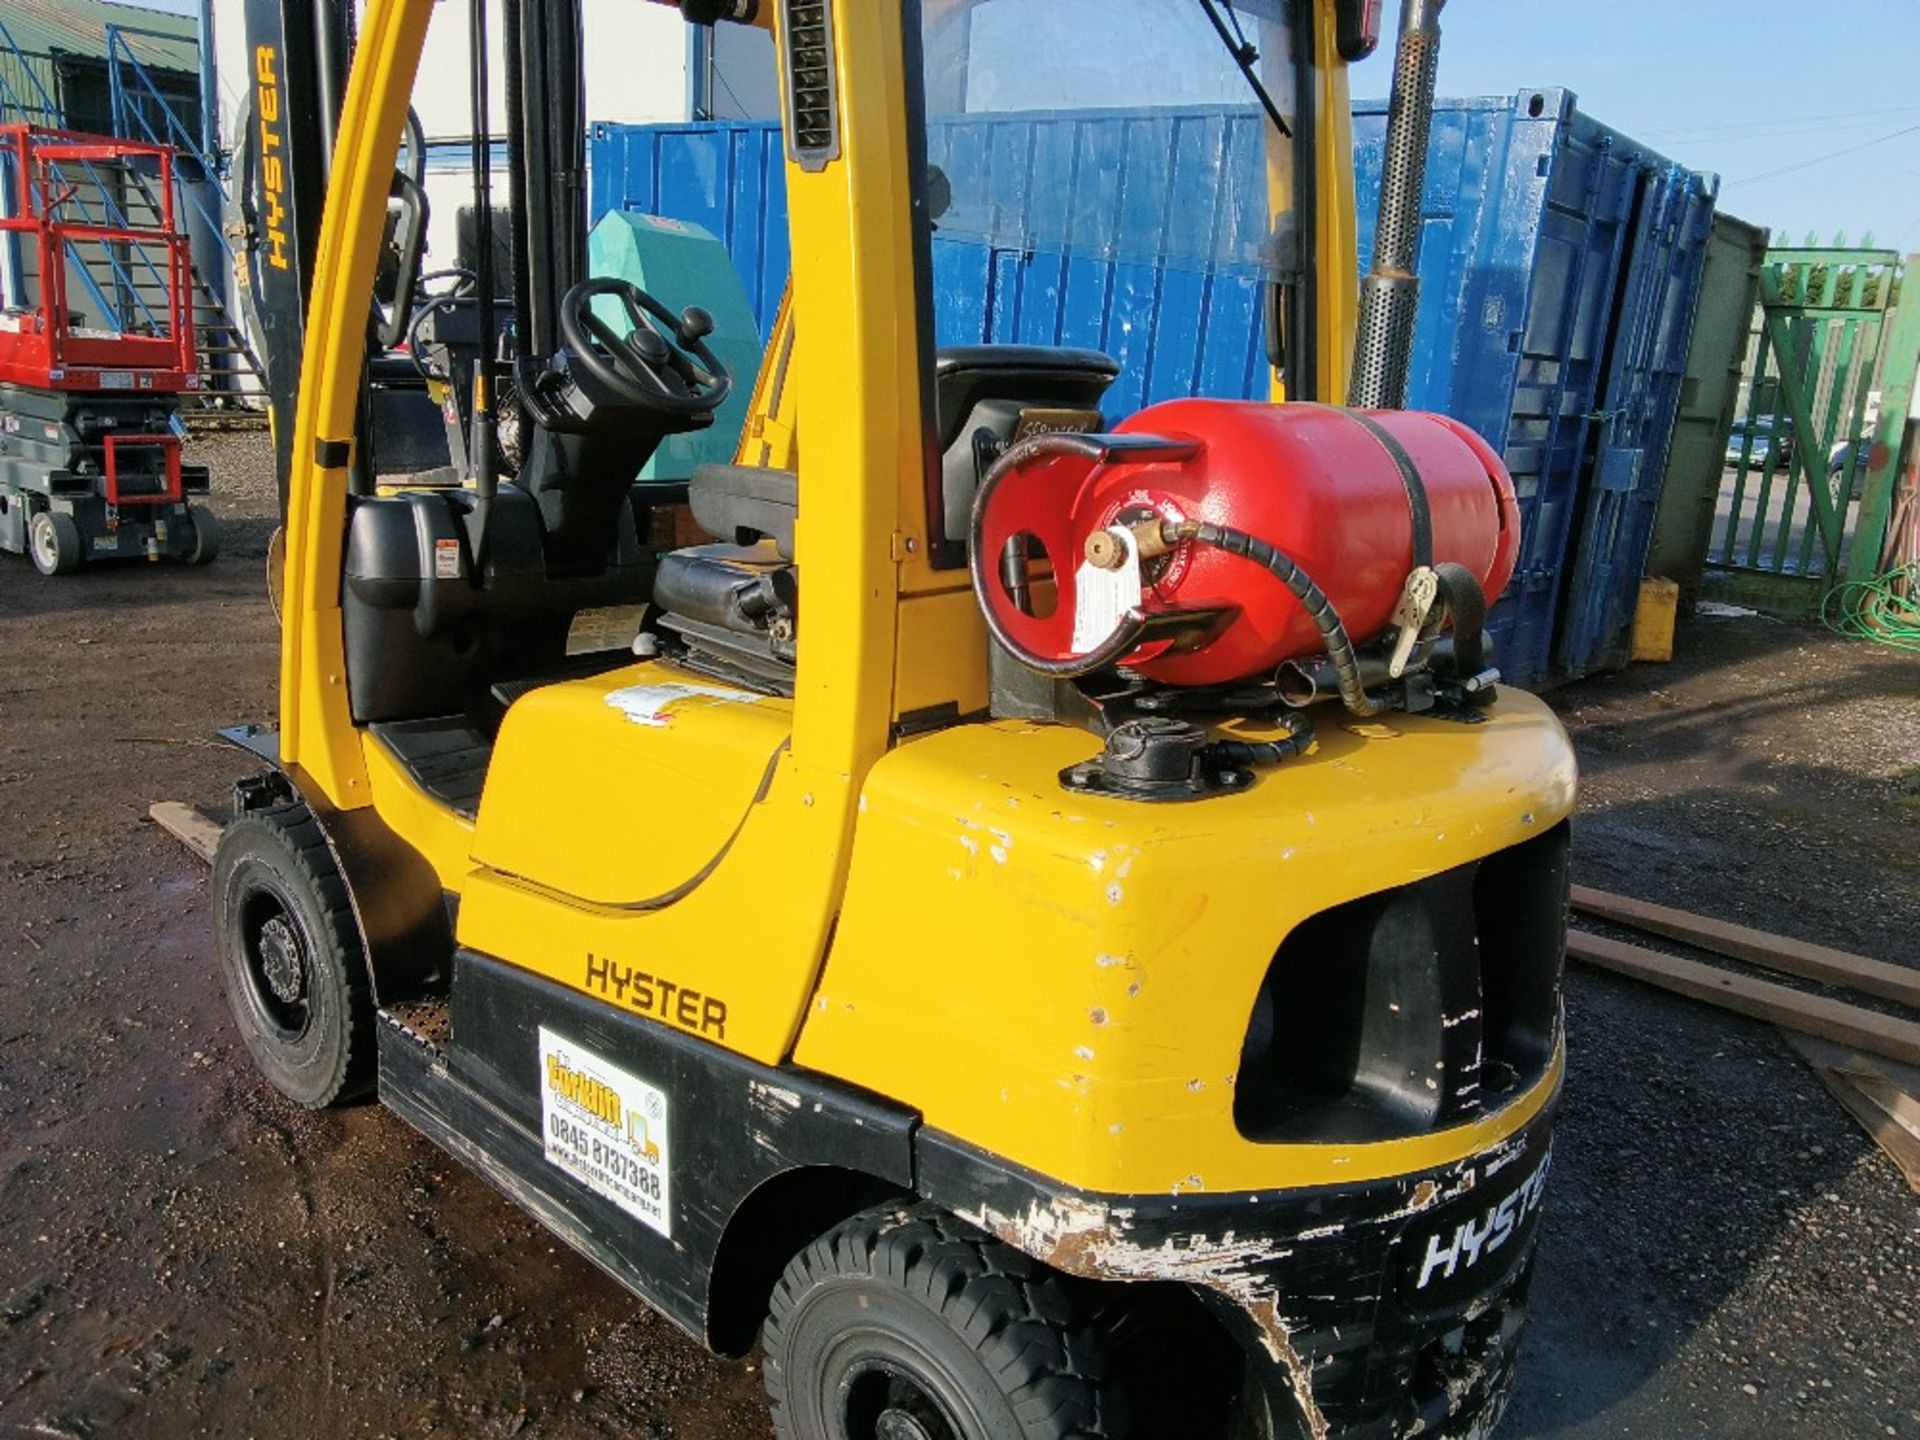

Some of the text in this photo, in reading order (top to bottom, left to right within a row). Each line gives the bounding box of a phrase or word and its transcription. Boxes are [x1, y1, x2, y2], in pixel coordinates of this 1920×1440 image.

[256, 45, 289, 270] HYSTER
[585, 952, 727, 1041] HYSTER
[550, 1112, 589, 1157] 0845
[592, 1137, 661, 1201] 8737388
[1416, 1150, 1550, 1289] HYSTE
